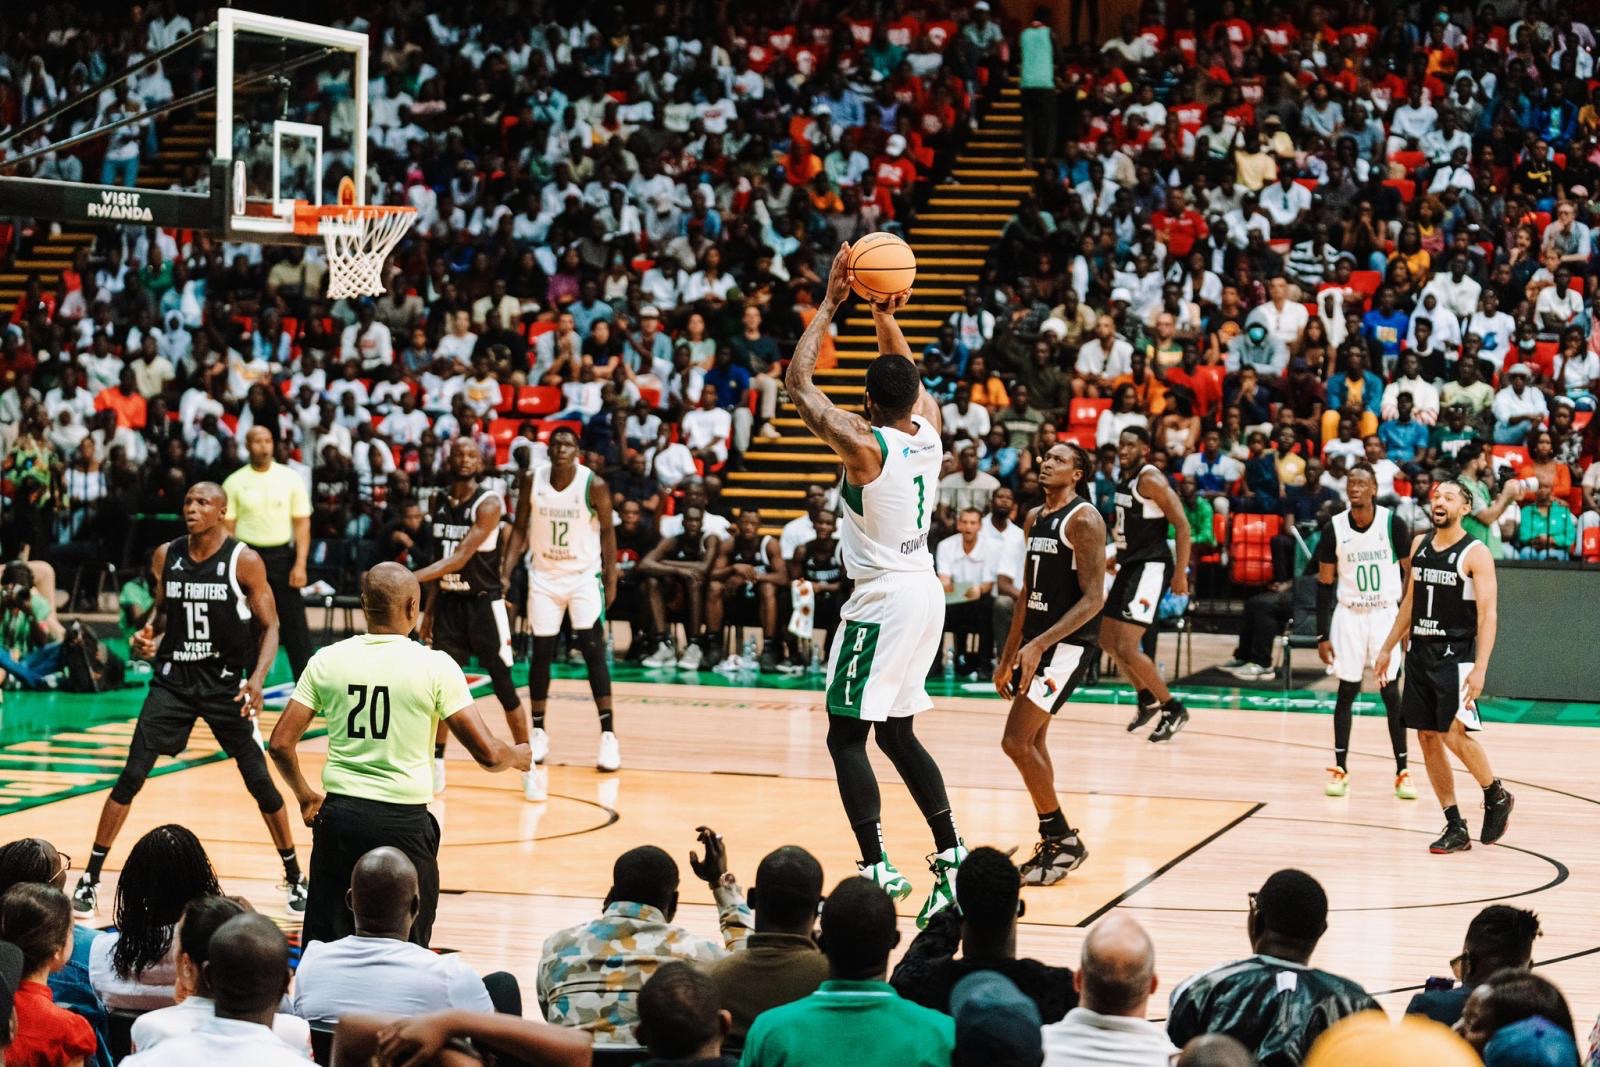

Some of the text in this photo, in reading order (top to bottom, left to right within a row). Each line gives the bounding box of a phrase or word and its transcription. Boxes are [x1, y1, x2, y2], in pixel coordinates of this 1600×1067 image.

[101, 191, 140, 206] VISIT
[88, 203, 153, 221] RWANDA
[913, 475, 924, 529] 1
[551, 521, 568, 546] 12
[1356, 564, 1380, 591] 00
[1423, 568, 1457, 586] FIGHTERS
[184, 582, 228, 600] FIGHTERS
[1426, 585, 1434, 618] 1
[183, 601, 210, 640] 15
[184, 641, 213, 652] VISIT
[844, 627, 868, 706] BAL
[347, 684, 391, 740] 20
